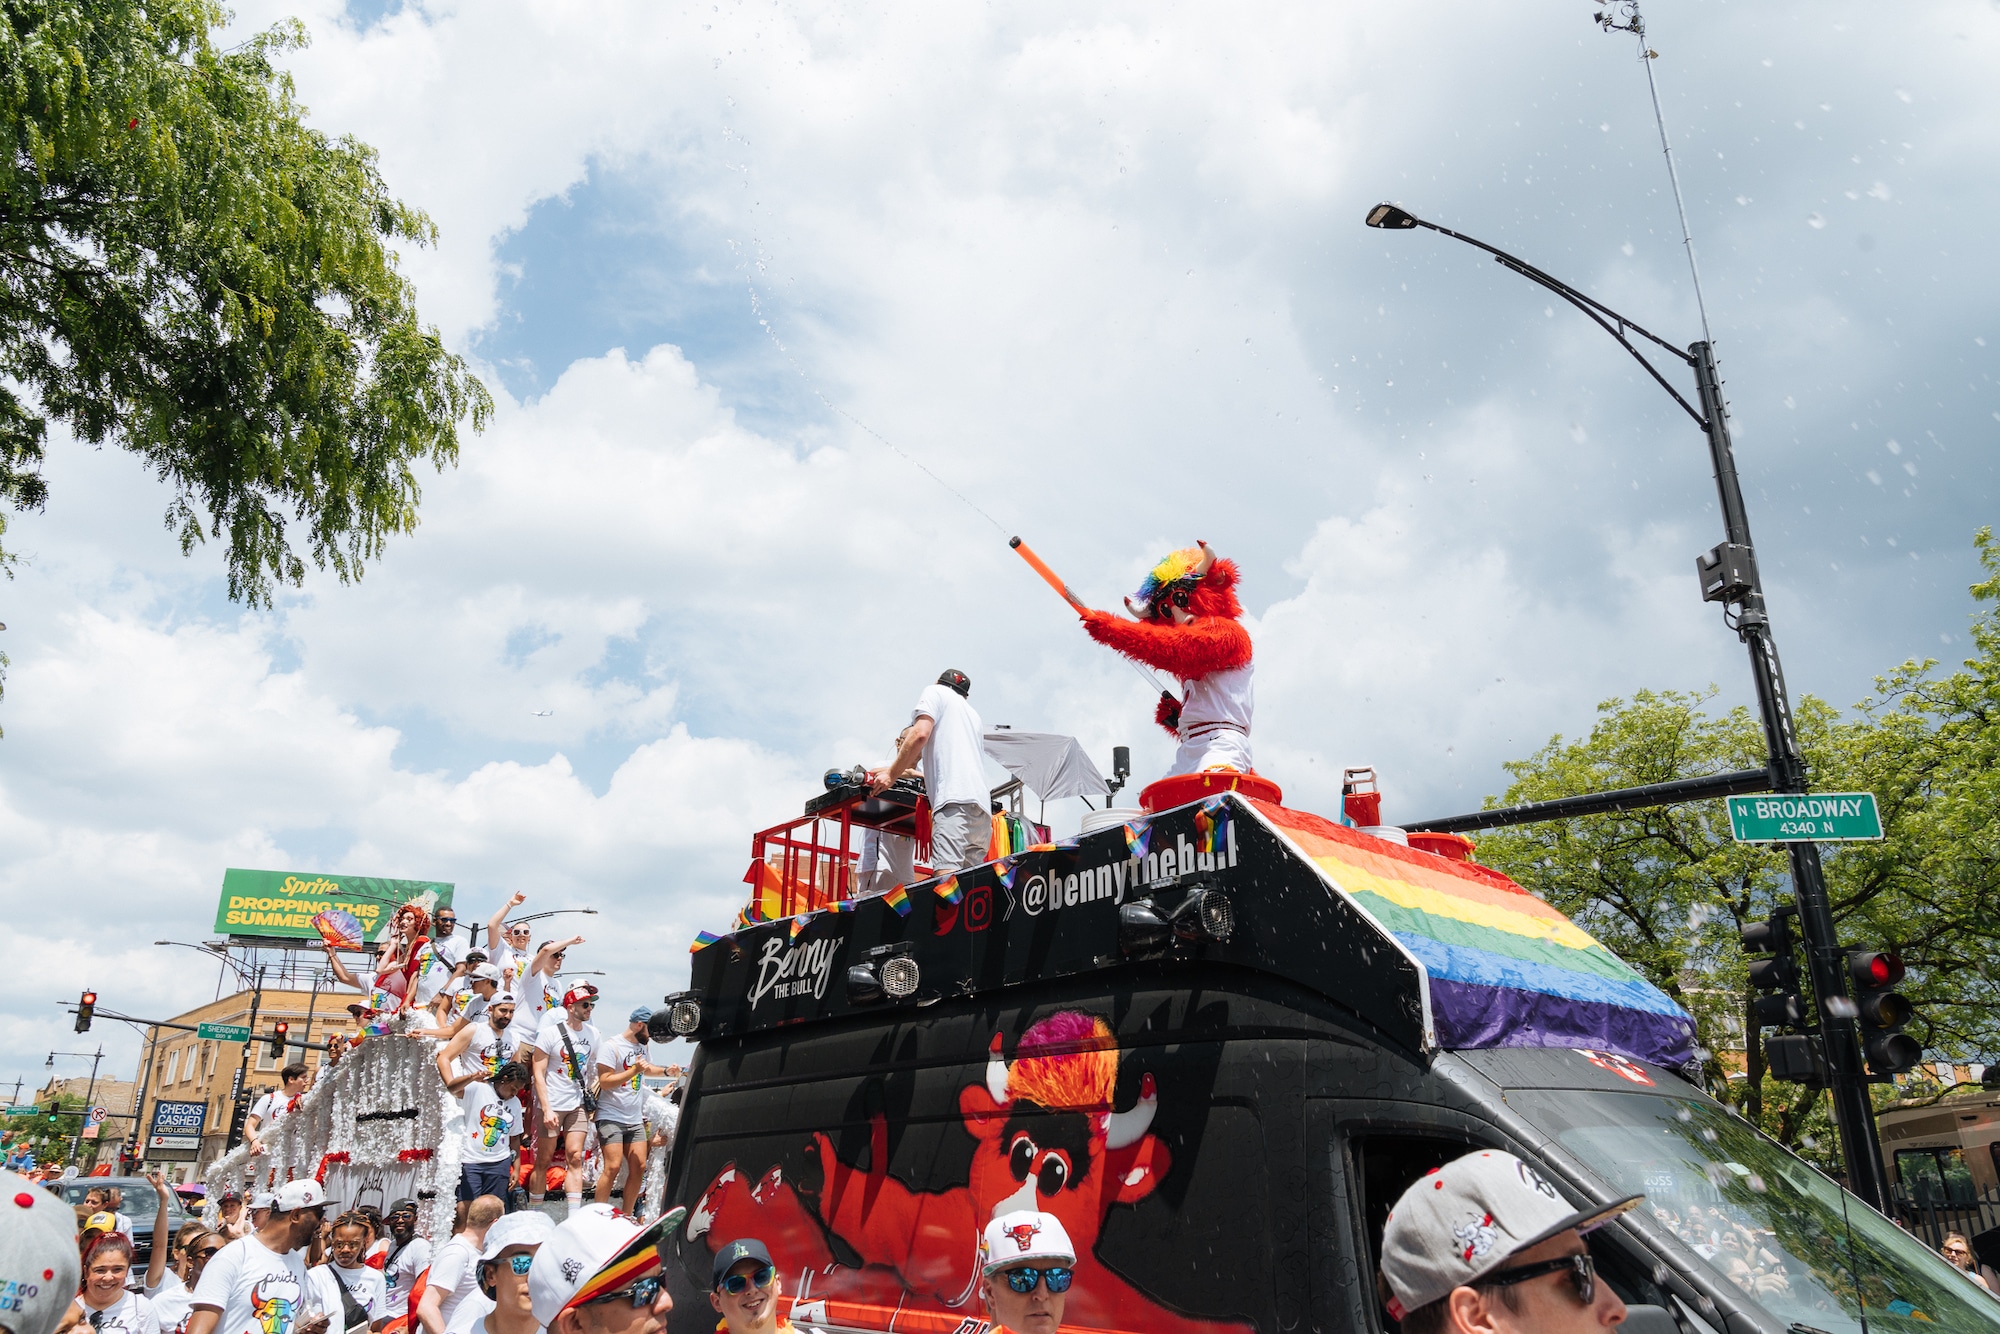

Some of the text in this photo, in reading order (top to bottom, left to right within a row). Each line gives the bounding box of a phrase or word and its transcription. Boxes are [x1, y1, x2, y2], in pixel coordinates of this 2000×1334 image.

[1763, 638, 1794, 753] BR4341
[1737, 799, 1863, 819] N BROADWAY
[1780, 821, 1834, 834] 4340 N
[279, 876, 339, 897] Sprite
[229, 896, 380, 918] DROPPING THIS
[747, 936, 844, 1011] Benny
[774, 978, 812, 999] THE BULL
[207, 1025, 239, 1034] SHERIDAN
[160, 1103, 203, 1115] CHECKS
[157, 1114, 201, 1126] CASHED
[260, 1270, 298, 1293] pride
